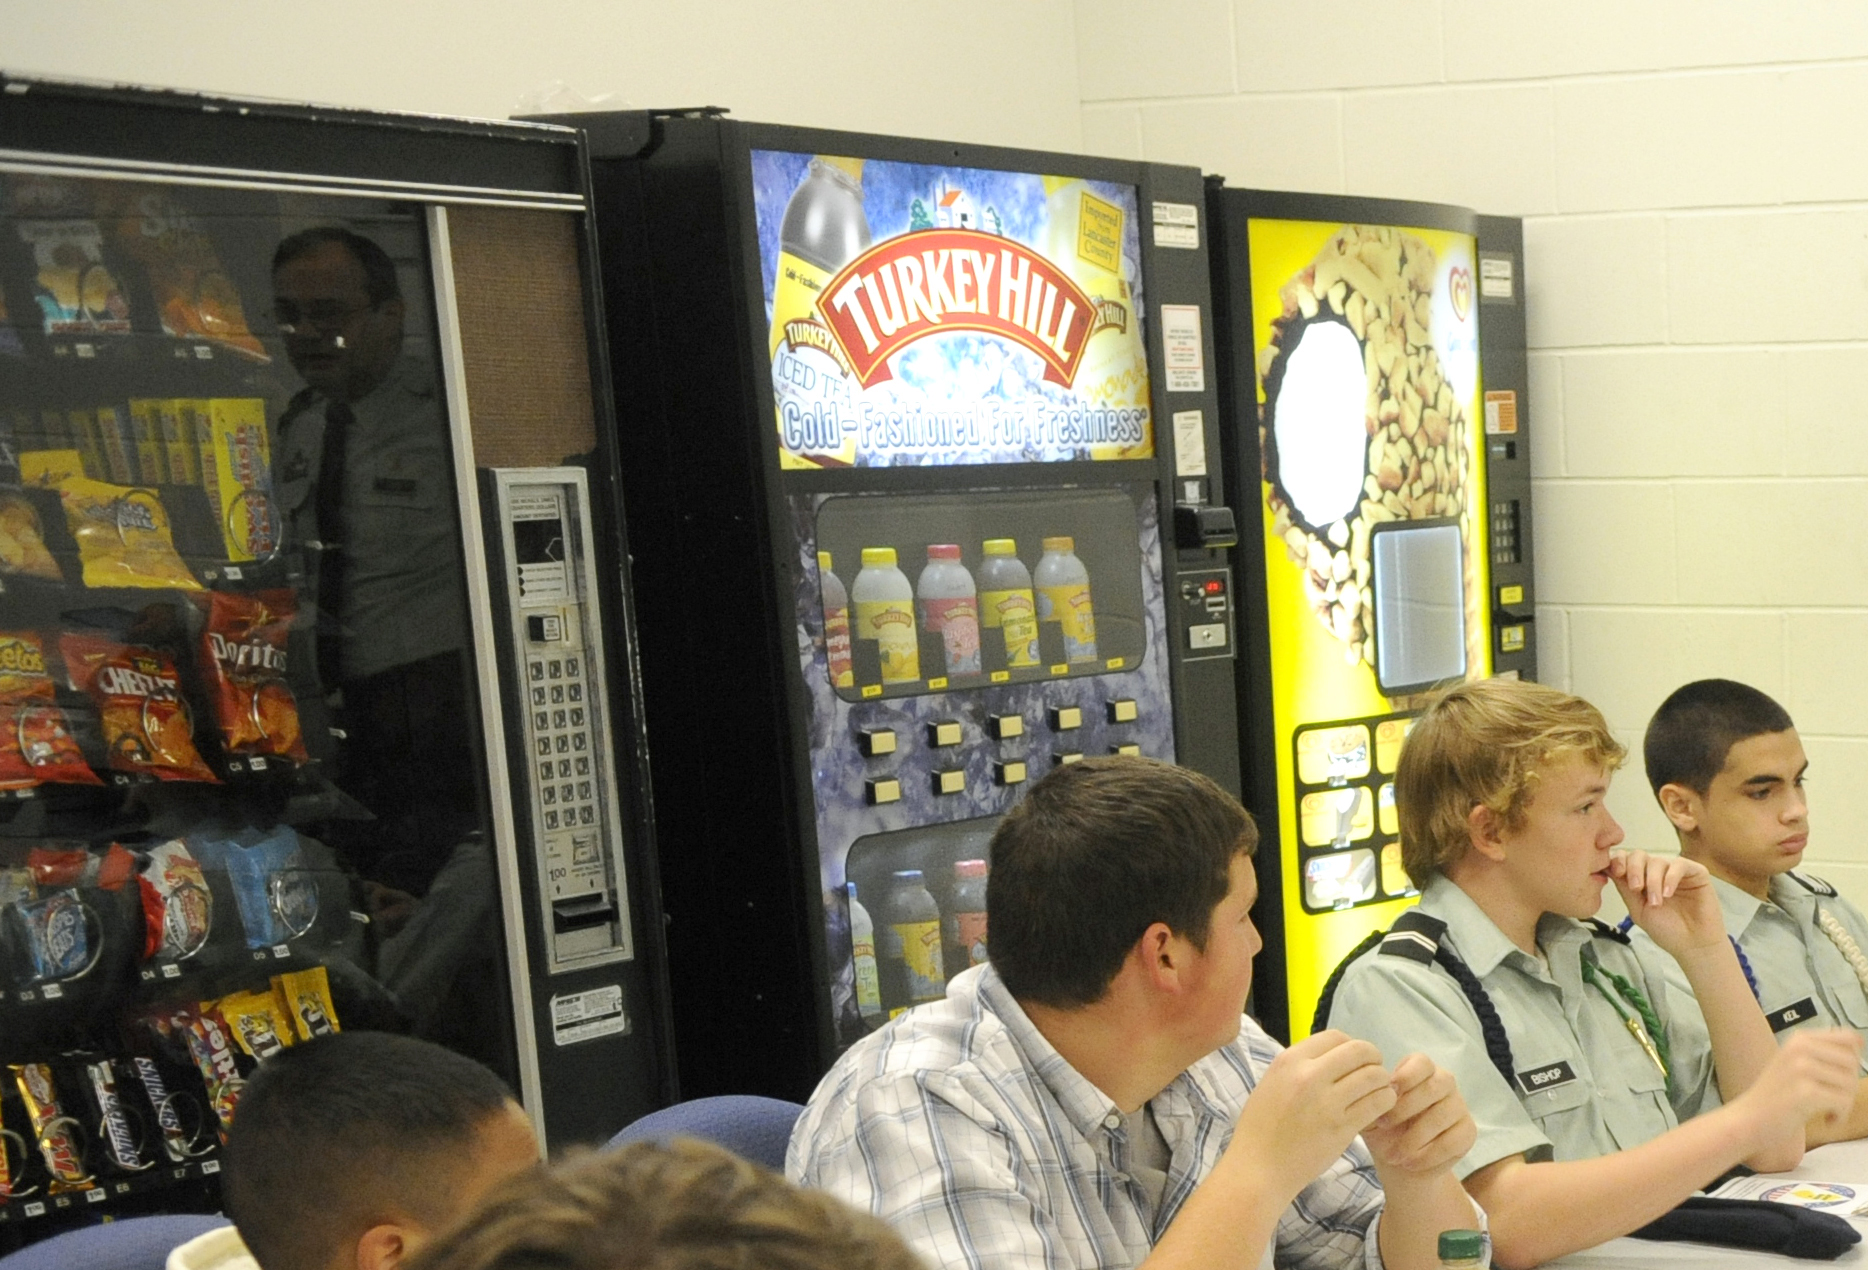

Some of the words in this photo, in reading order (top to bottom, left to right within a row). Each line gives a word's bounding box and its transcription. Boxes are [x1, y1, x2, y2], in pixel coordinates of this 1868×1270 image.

[833, 248, 999, 355] TURKEY
[997, 257, 1084, 364] HILL
[785, 322, 834, 354] TURKEY
[778, 352, 816, 391] ICED
[782, 400, 980, 450] Cold-Fashioned
[987, 401, 1024, 448] For
[0, 643, 44, 672] etos
[208, 632, 287, 672] Doritos
[1530, 1067, 1562, 1085] BISHOP
